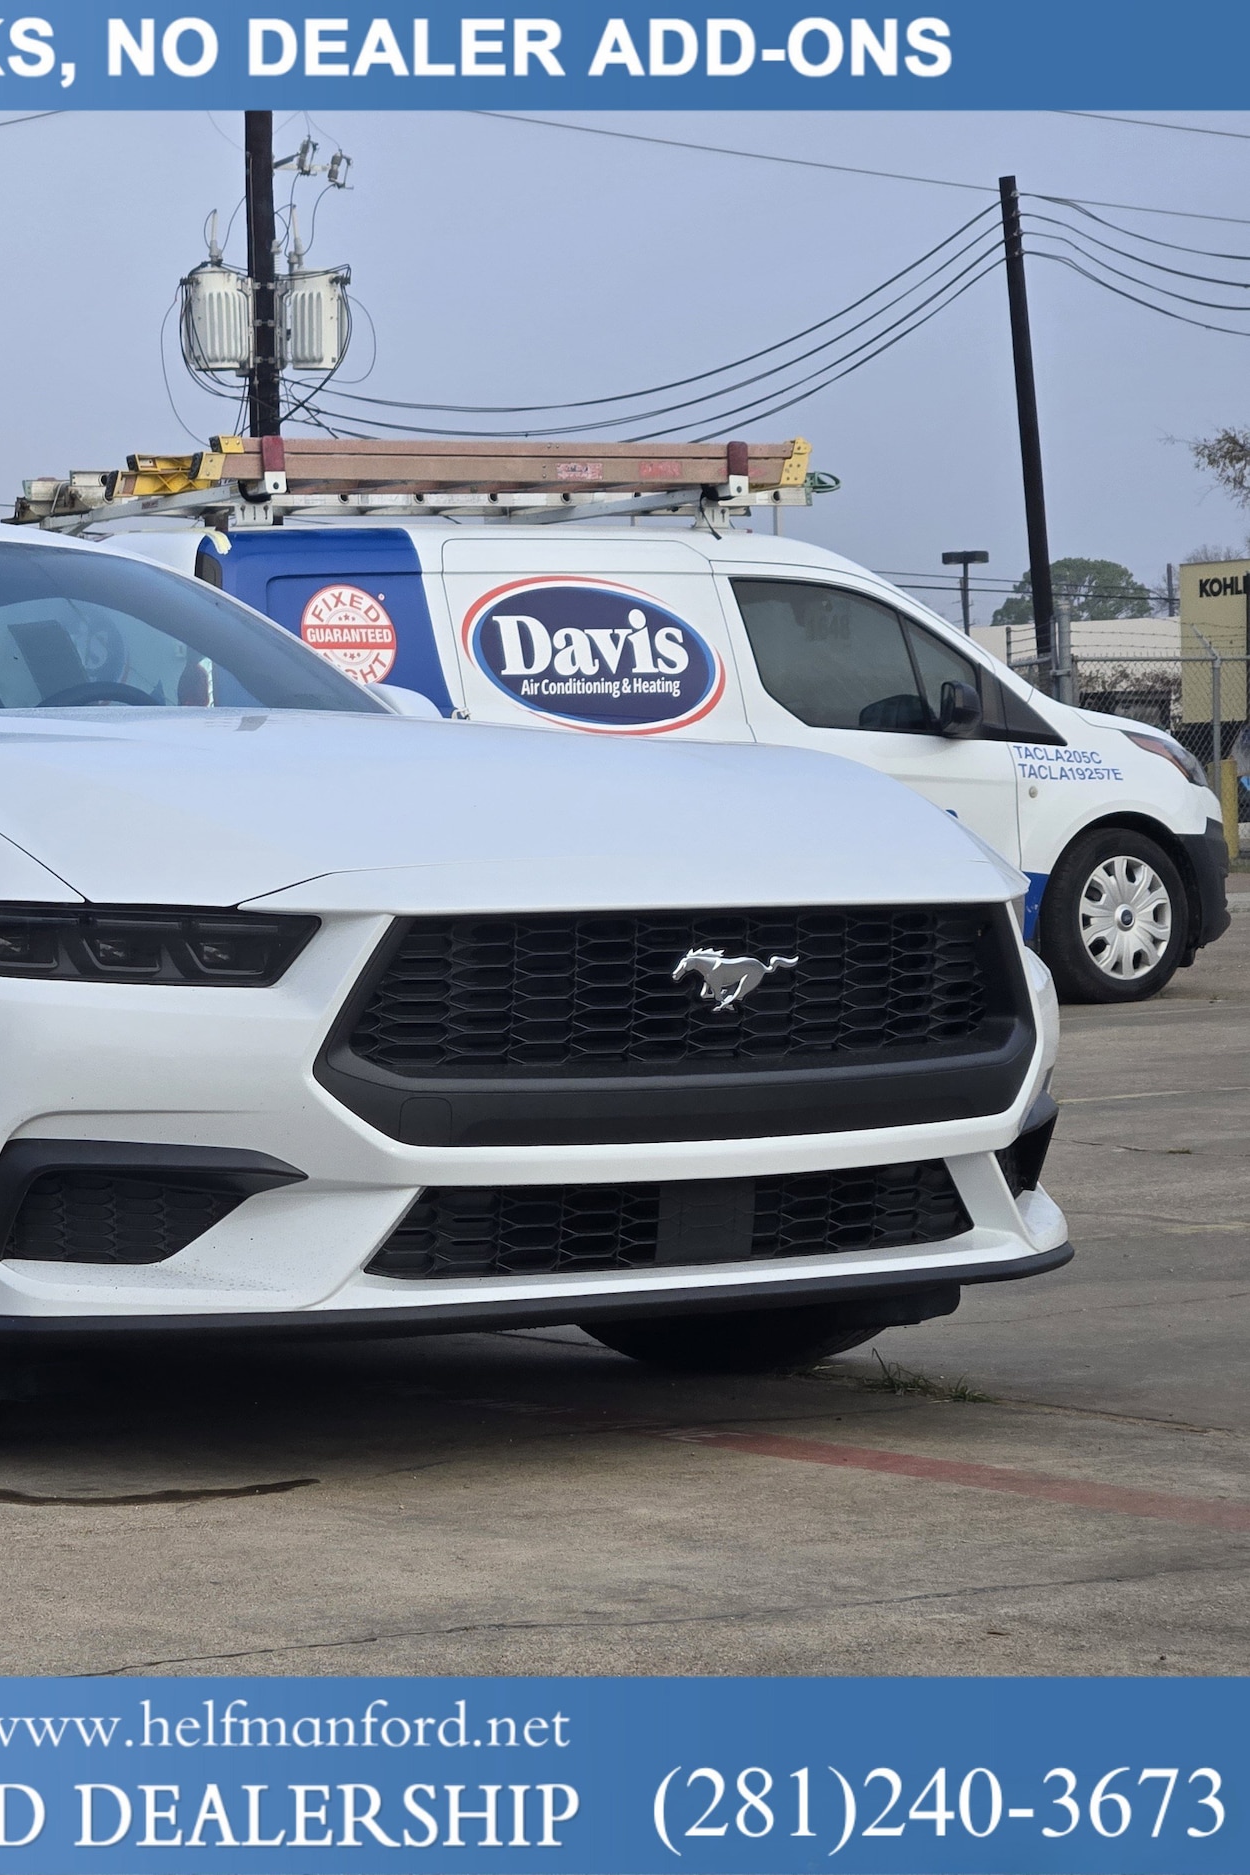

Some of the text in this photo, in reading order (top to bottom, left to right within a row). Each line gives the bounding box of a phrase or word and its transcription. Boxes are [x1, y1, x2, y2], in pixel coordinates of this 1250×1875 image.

[311, 591, 381, 623] FIXED
[306, 628, 393, 643] GUARANTEED
[492, 608, 689, 676] Davis
[521, 676, 681, 698] Air Conditioning & Heating
[1013, 745, 1102, 765] TACLA205C
[1017, 763, 1124, 781] TACLA19257E
